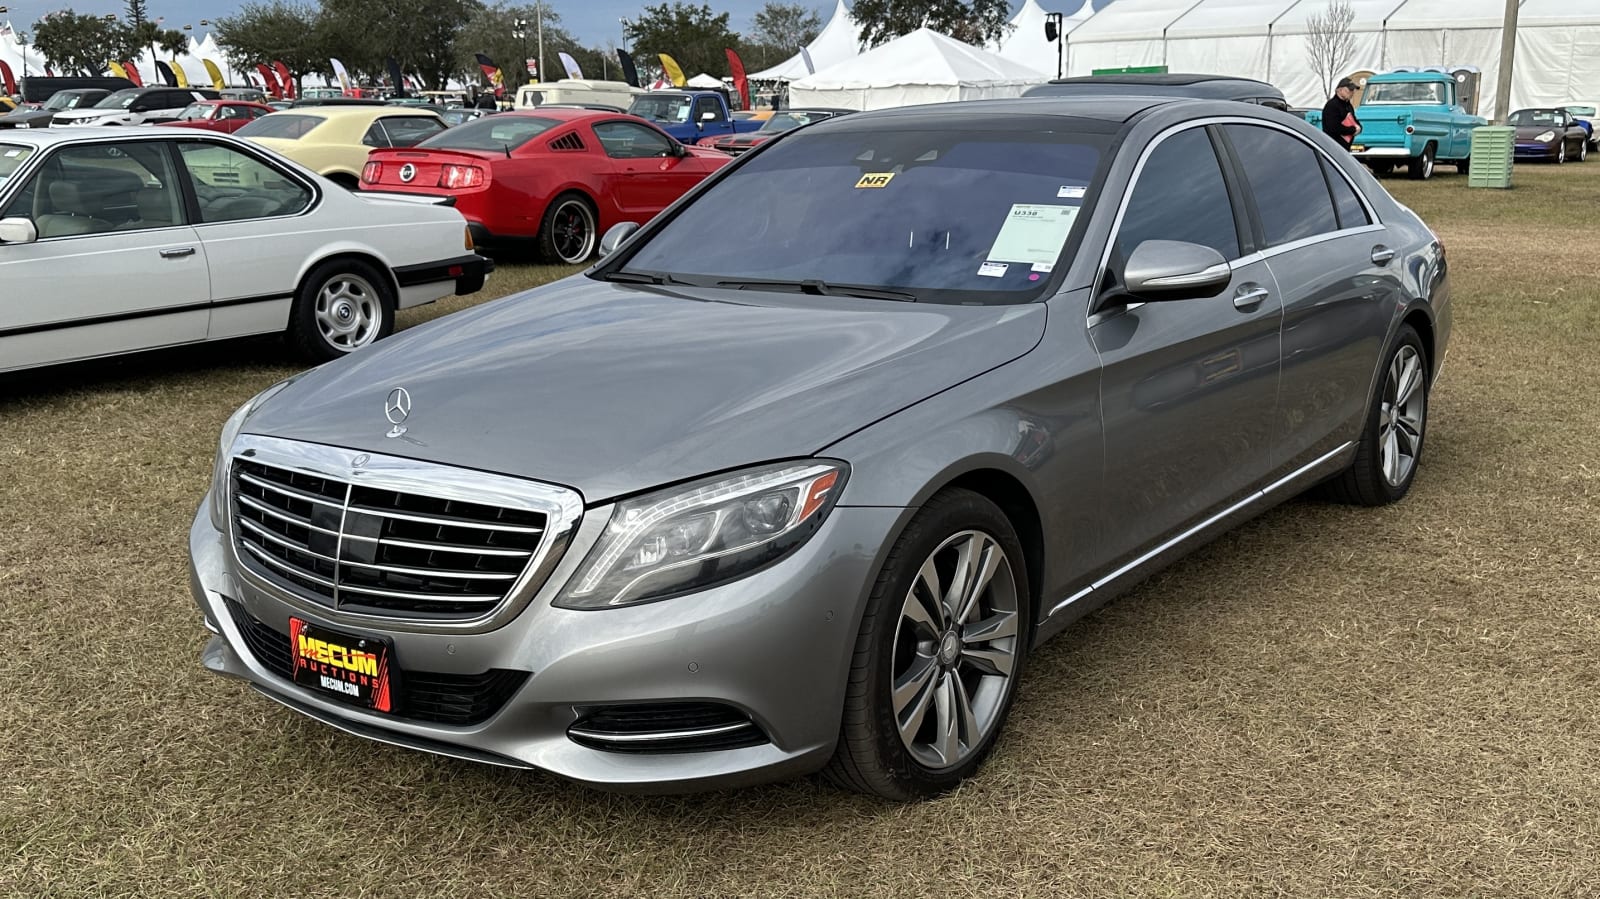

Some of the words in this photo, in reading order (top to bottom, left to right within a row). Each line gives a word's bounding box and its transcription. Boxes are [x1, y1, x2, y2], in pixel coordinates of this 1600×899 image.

[860, 176, 888, 185] NR
[298, 634, 378, 677] MECUM
[300, 658, 379, 688] AUCTIONS
[320, 675, 359, 697] MECUM.COM
